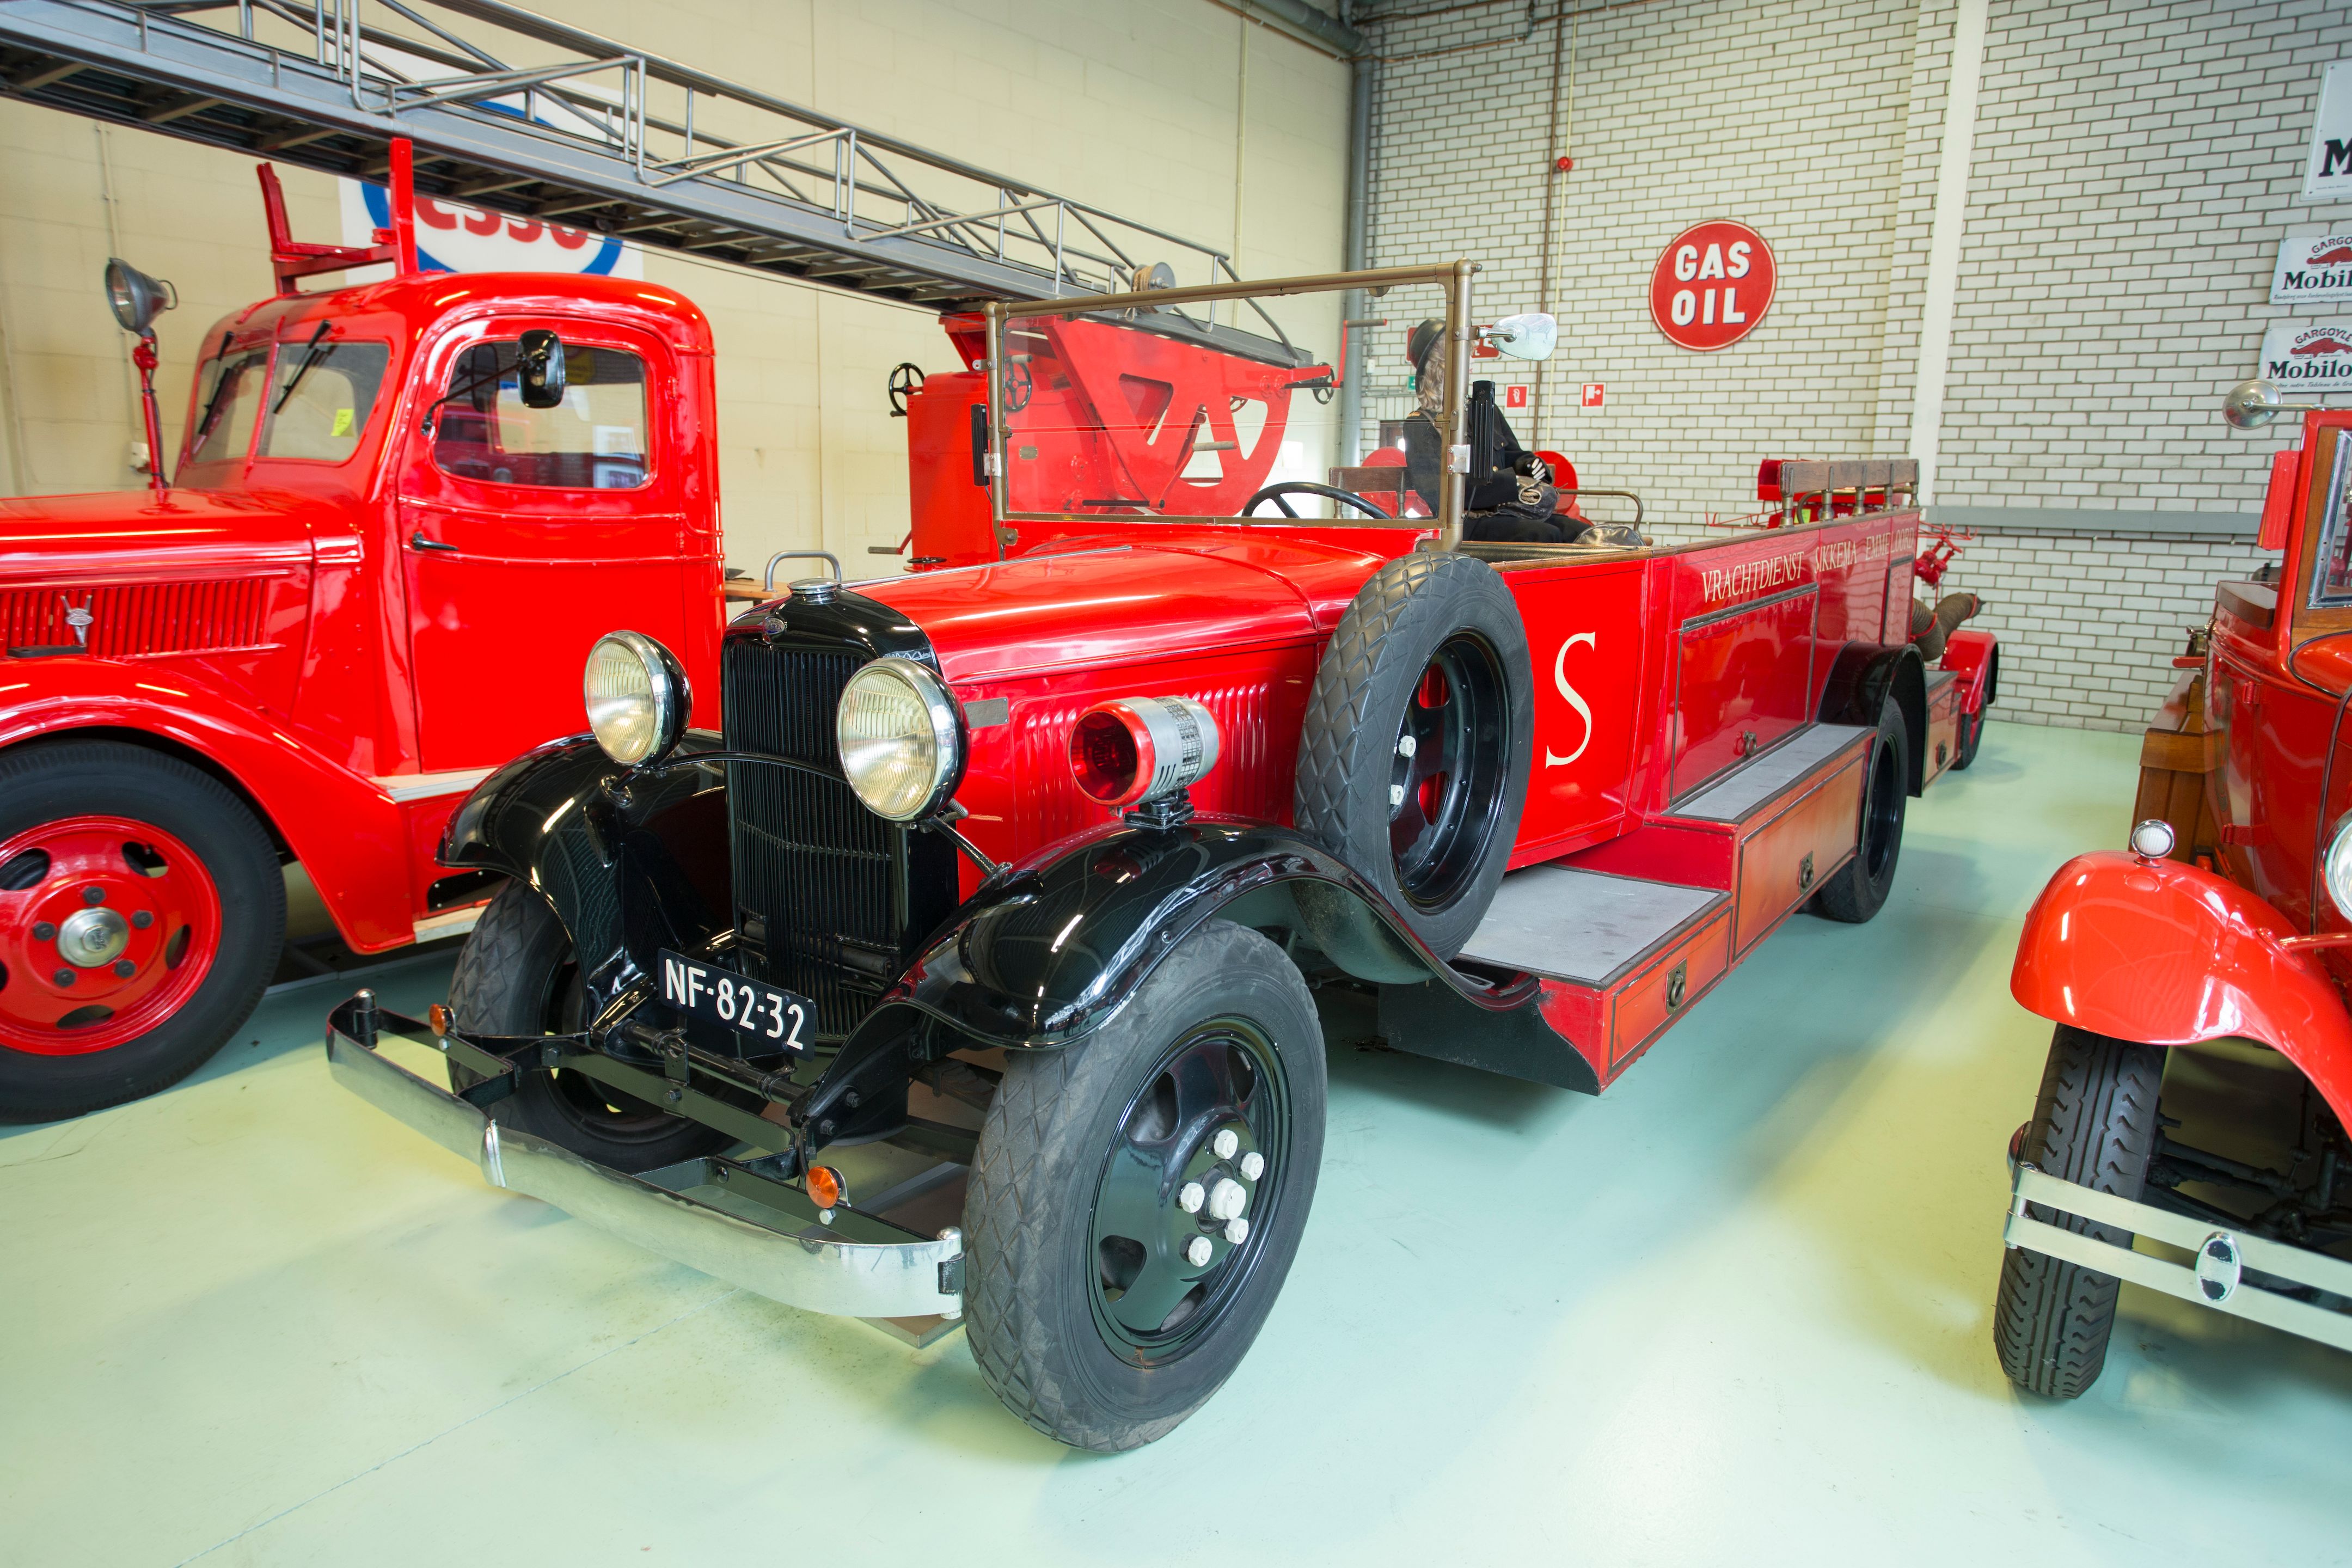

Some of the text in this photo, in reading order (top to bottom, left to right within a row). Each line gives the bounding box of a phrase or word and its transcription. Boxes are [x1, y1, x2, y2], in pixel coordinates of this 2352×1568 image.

[1675, 241, 1751, 281] GAS
[1671, 287, 1746, 326] OIL
[2294, 328, 2352, 344] GARGOYLE
[1702, 527, 1915, 603] VRACHTDIENST SIKKEMA EMMELOORD
[1545, 631, 1596, 769] S
[665, 958, 804, 1050] NF-82-32
